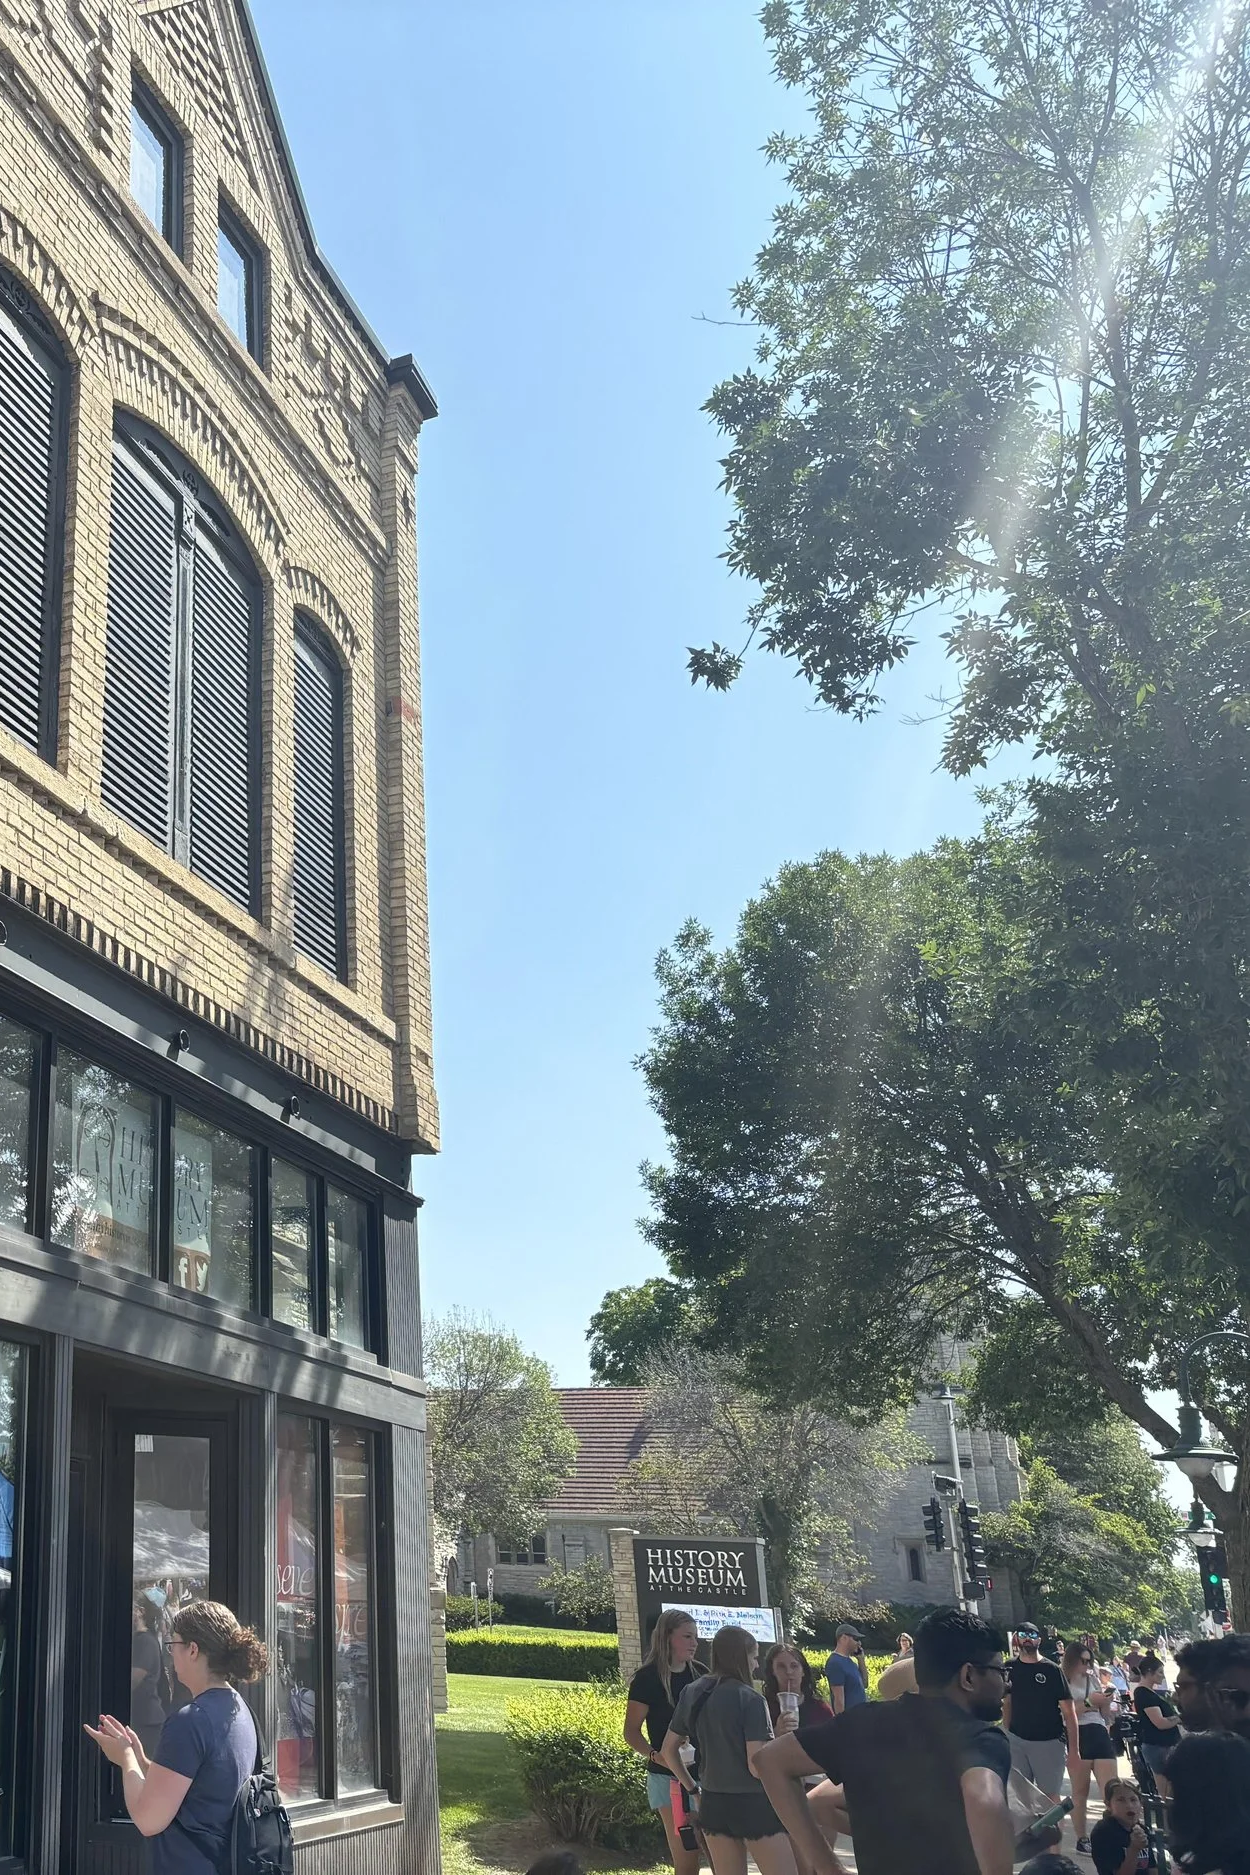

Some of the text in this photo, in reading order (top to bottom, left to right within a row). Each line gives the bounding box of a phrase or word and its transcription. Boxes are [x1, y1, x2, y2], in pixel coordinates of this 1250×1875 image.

[646, 1548, 744, 1569] HISTORY
[648, 1567, 747, 1588] MUSEUM
[698, 1587, 747, 1596] CASTLE
